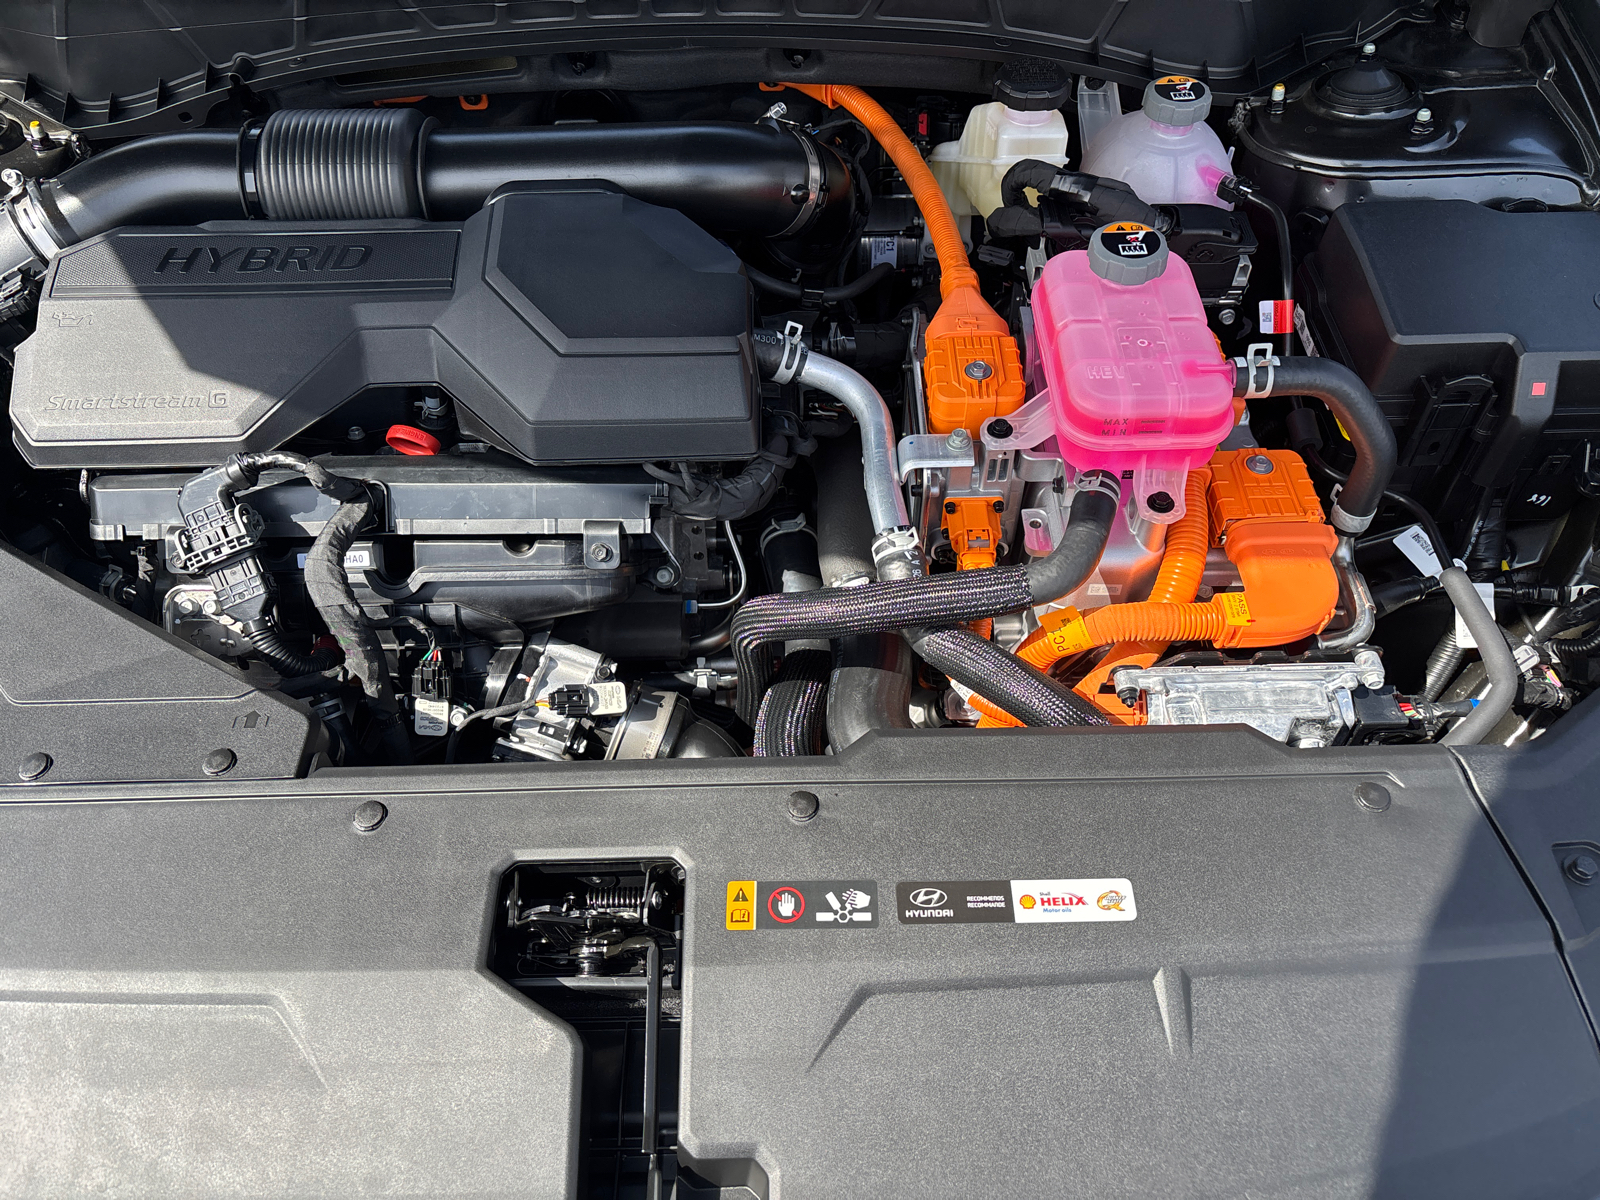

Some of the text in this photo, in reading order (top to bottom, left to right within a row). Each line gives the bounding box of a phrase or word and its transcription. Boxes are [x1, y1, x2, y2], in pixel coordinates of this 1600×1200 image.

[154, 244, 374, 274] HYBRID
[1086, 365, 1125, 379] HEV
[45, 391, 229, 411] Smartstream G
[1103, 418, 1129, 426] MAX
[1235, 593, 1248, 615] PASS
[1051, 627, 1071, 653] PC
[905, 908, 954, 918] HYUNDAI
[1040, 896, 1088, 907] HELIX
